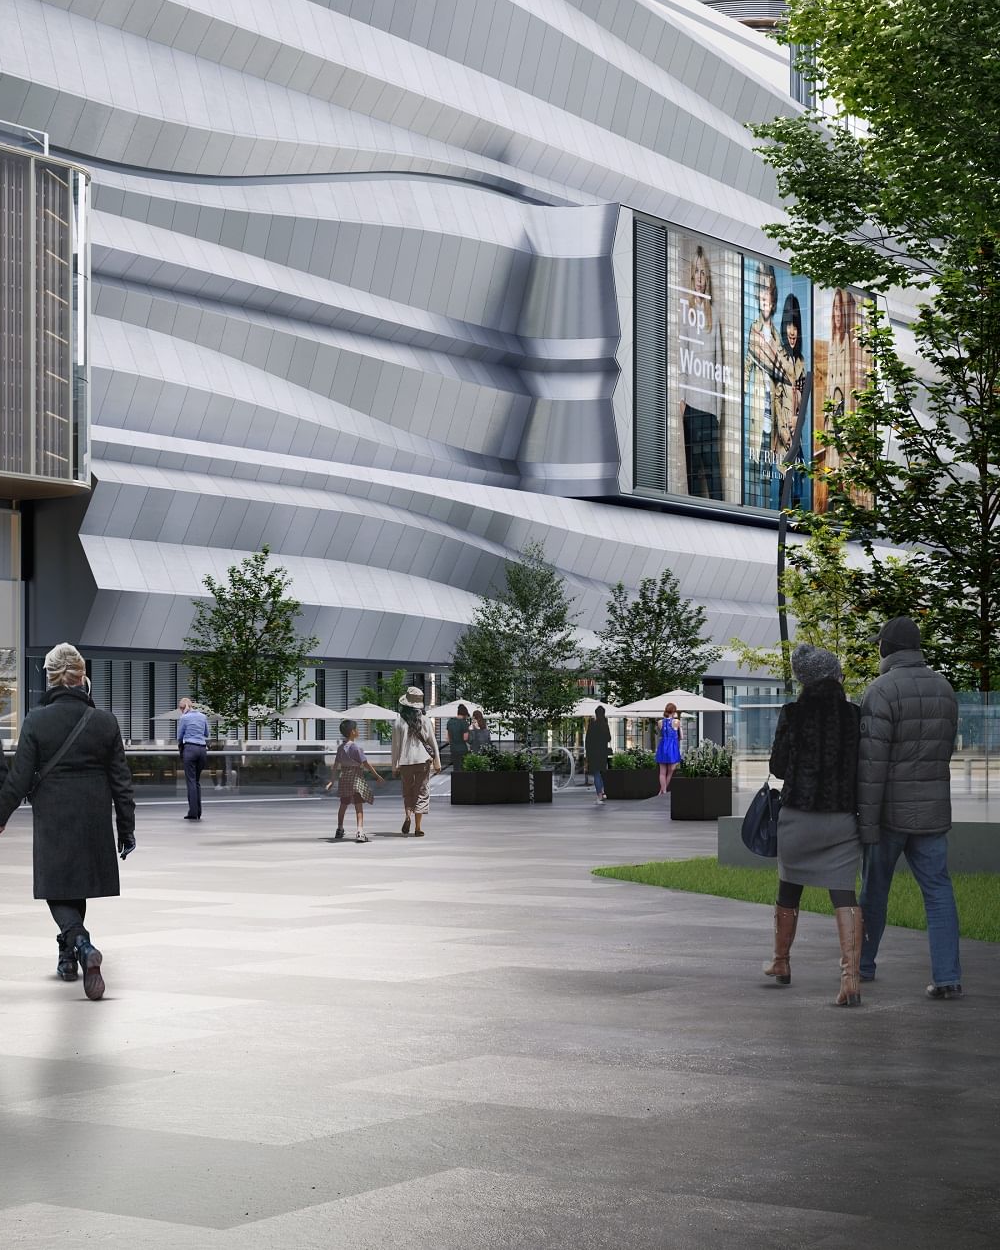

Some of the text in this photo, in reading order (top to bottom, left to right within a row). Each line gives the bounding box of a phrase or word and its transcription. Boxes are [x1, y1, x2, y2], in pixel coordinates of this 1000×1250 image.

[680, 298, 705, 335] Top
[680, 347, 731, 384] Woman
[762, 470, 795, 482] CHILD
